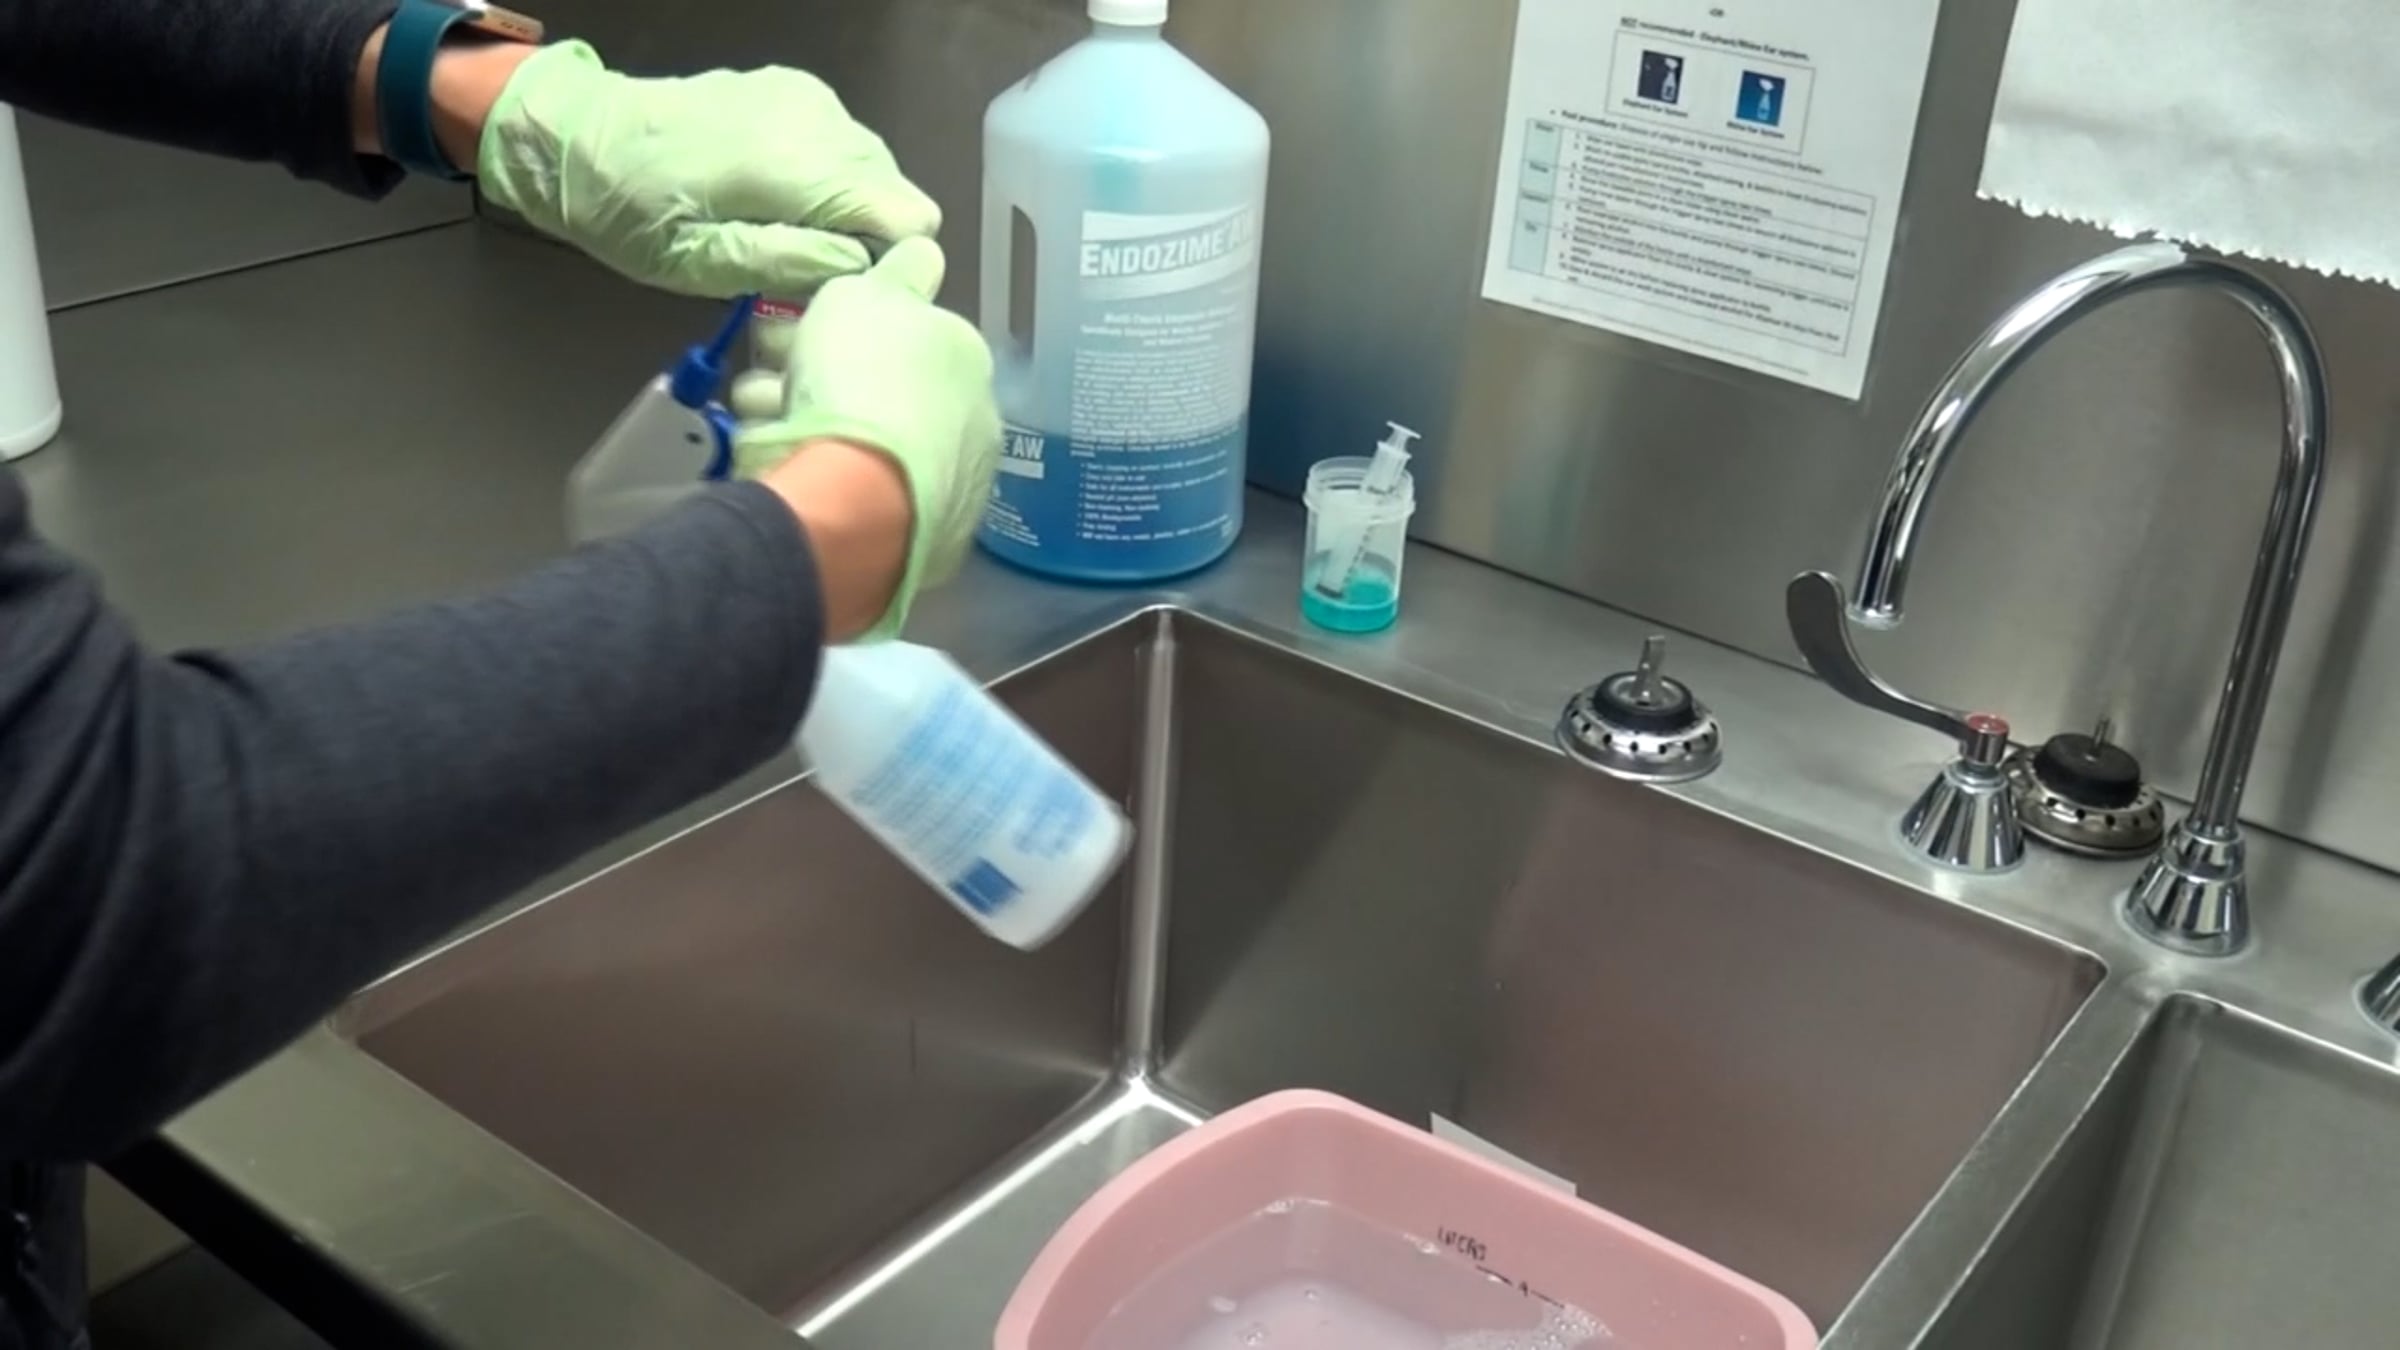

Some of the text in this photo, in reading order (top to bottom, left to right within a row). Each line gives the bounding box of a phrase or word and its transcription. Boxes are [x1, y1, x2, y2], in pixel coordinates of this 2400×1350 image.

[1639, 21, 1695, 38] recommended
[1080, 228, 1225, 277] ENDOZIME
[1011, 434, 1045, 460] AW
